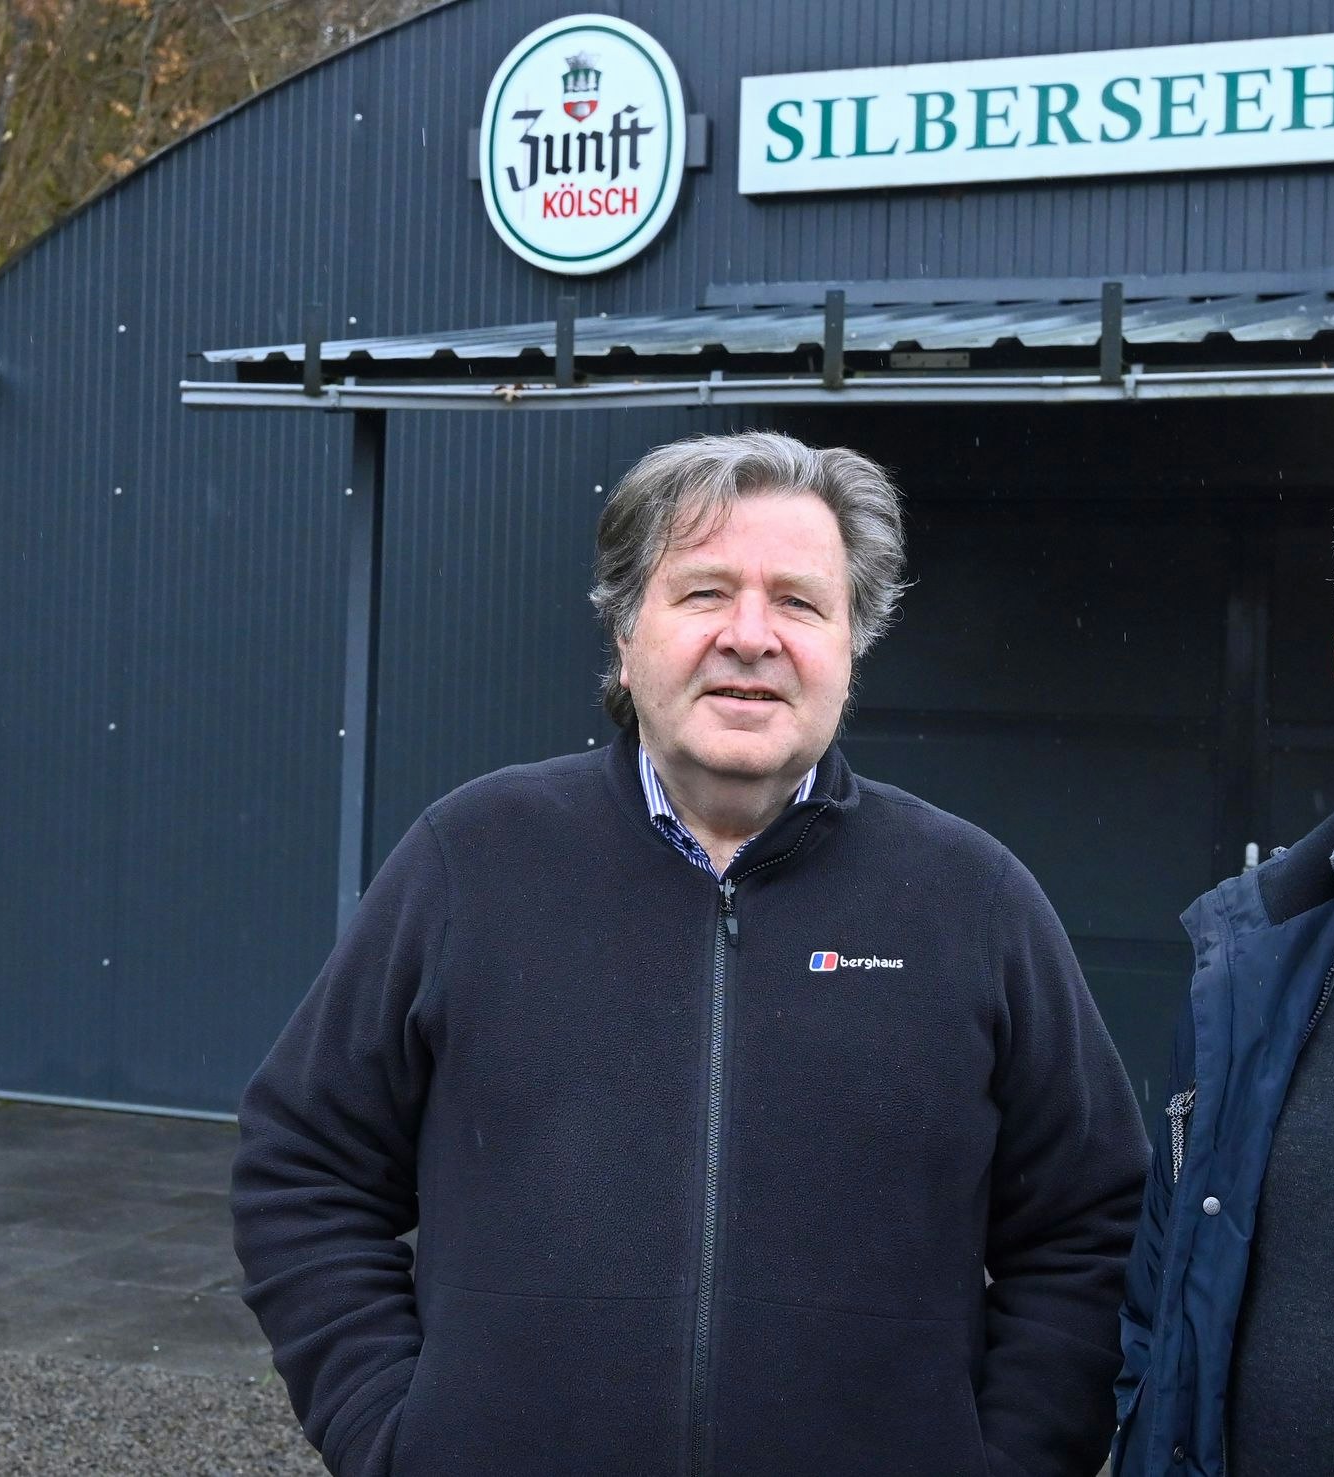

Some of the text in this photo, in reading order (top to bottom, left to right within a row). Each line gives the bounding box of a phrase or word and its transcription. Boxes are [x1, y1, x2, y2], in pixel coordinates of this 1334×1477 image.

[505, 104, 658, 193] Zunft
[542, 182, 638, 219] KÖLSCH
[839, 954, 904, 970] berghaus
